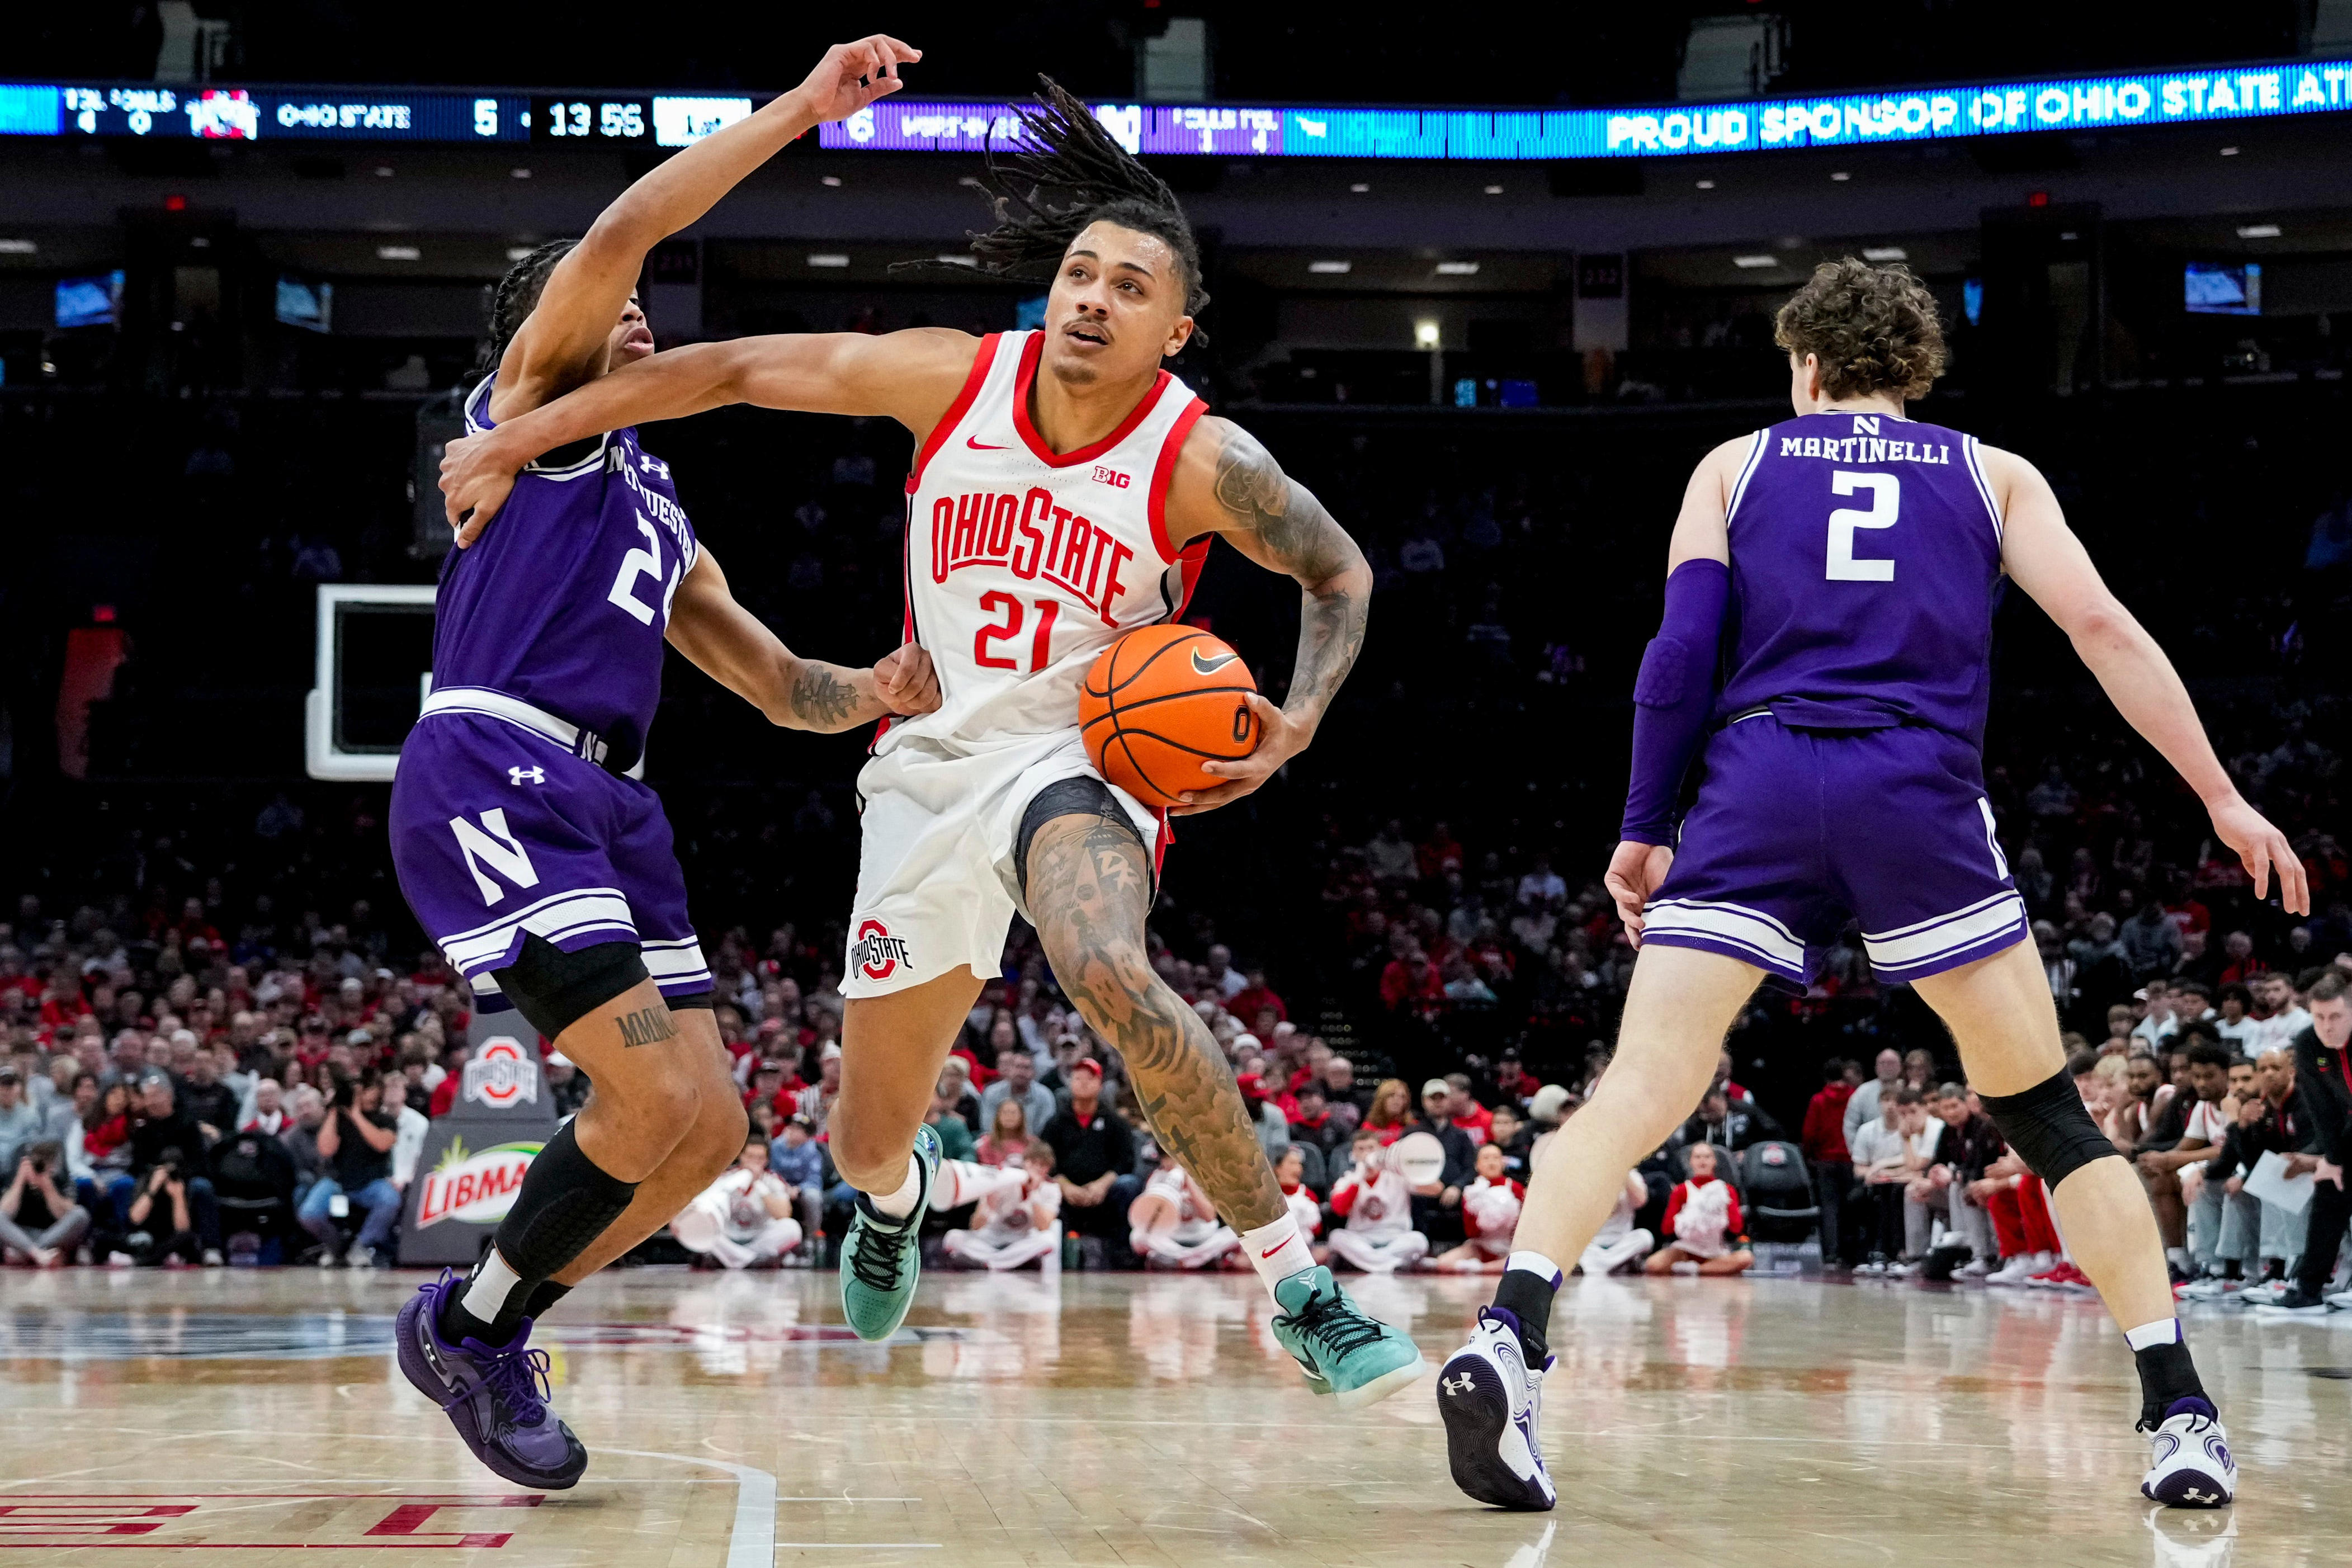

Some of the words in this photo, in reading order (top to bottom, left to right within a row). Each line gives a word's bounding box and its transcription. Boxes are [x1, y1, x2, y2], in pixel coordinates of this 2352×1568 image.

[475, 100, 497, 136] 5
[1608, 110, 1747, 149] PROUD
[1760, 96, 1958, 143] SPONSOR
[1969, 91, 2026, 128] OF
[2036, 83, 2151, 124] OHIO
[2162, 74, 2279, 115] STATE
[2293, 68, 2352, 106] AT
[1780, 437, 1949, 465] MARTINELLI
[1853, 415, 1879, 436] N
[1826, 470, 1900, 581] 2
[974, 589, 1060, 673] 21
[449, 807, 540, 907] N
[423, 1161, 528, 1221] LIBMA
